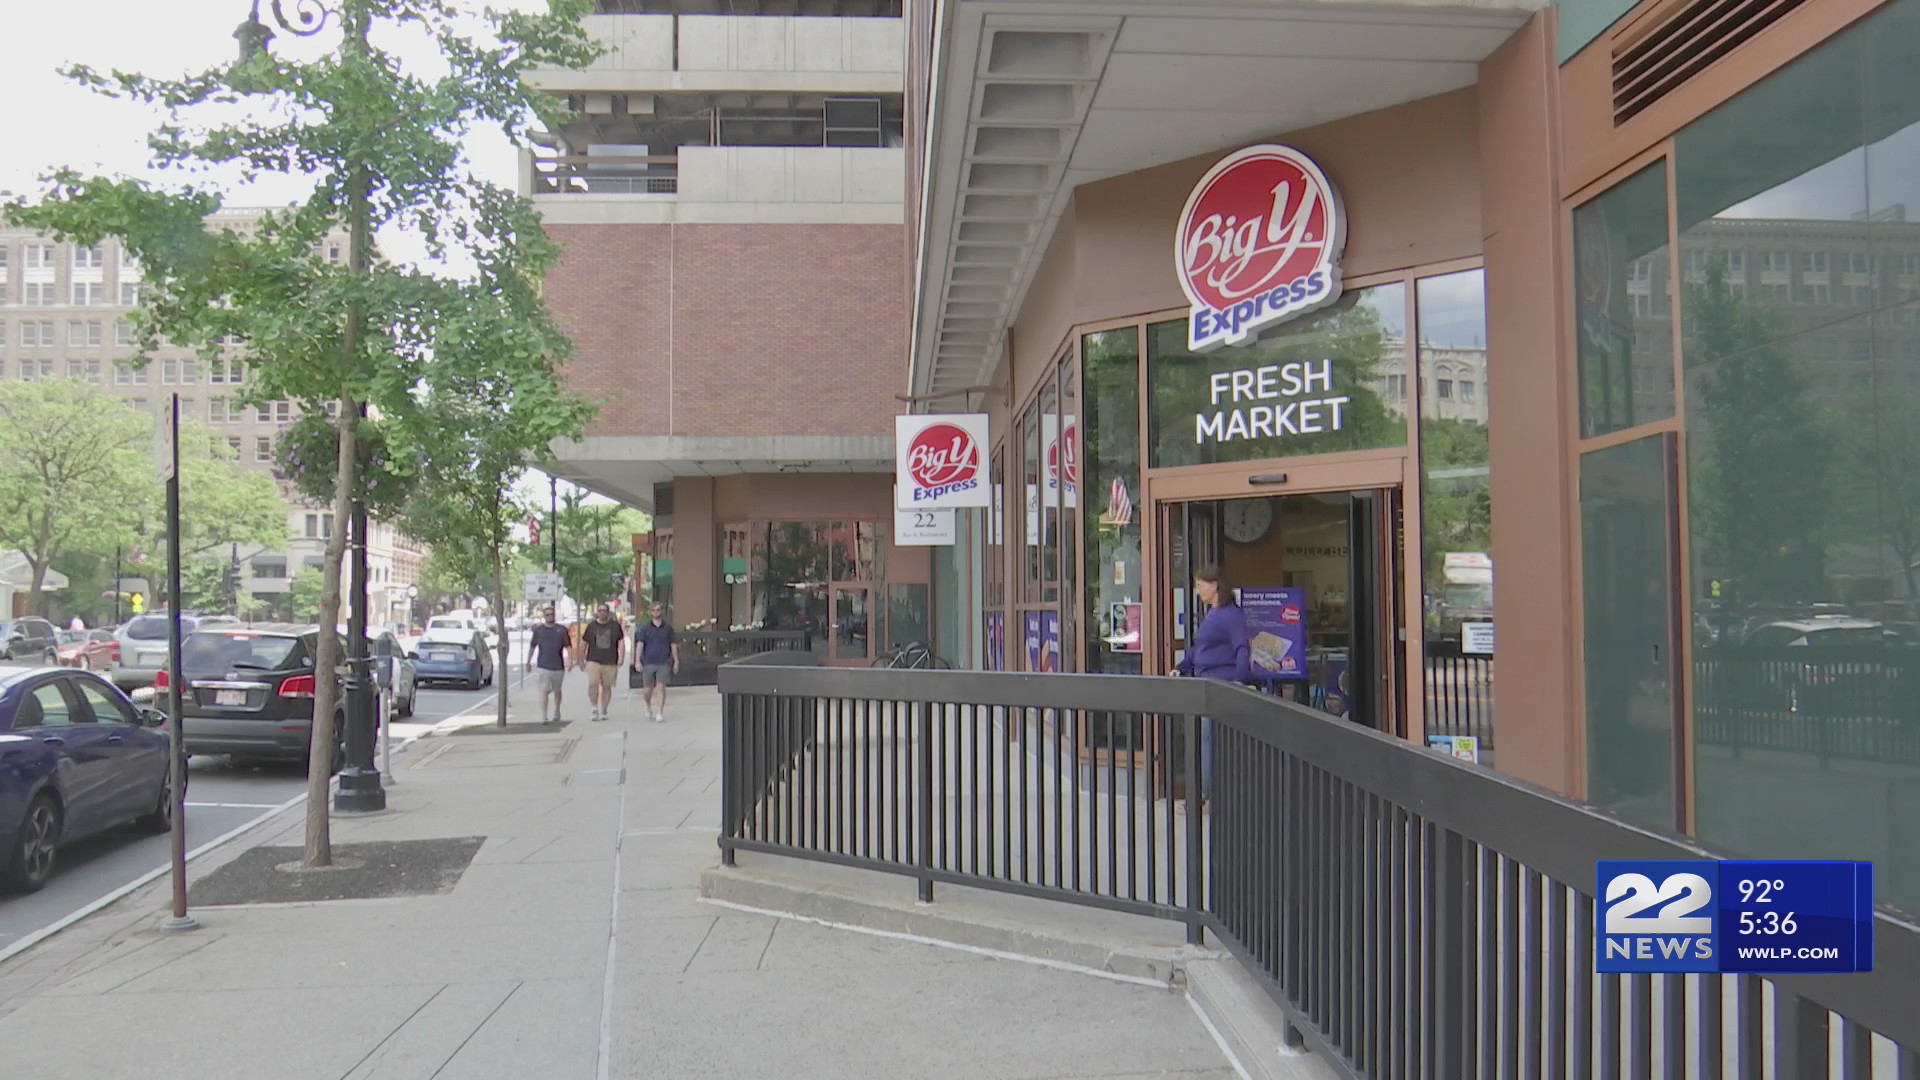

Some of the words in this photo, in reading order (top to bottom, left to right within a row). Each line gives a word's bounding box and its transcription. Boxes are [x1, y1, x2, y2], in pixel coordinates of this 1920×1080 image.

[1187, 213, 1263, 280] Big
[1194, 271, 1325, 342] Express
[1210, 359, 1333, 405] FRESH
[1195, 396, 1350, 445] MARKET
[908, 444, 948, 475] Big
[913, 478, 978, 501] Express
[913, 513, 937, 528] 22
